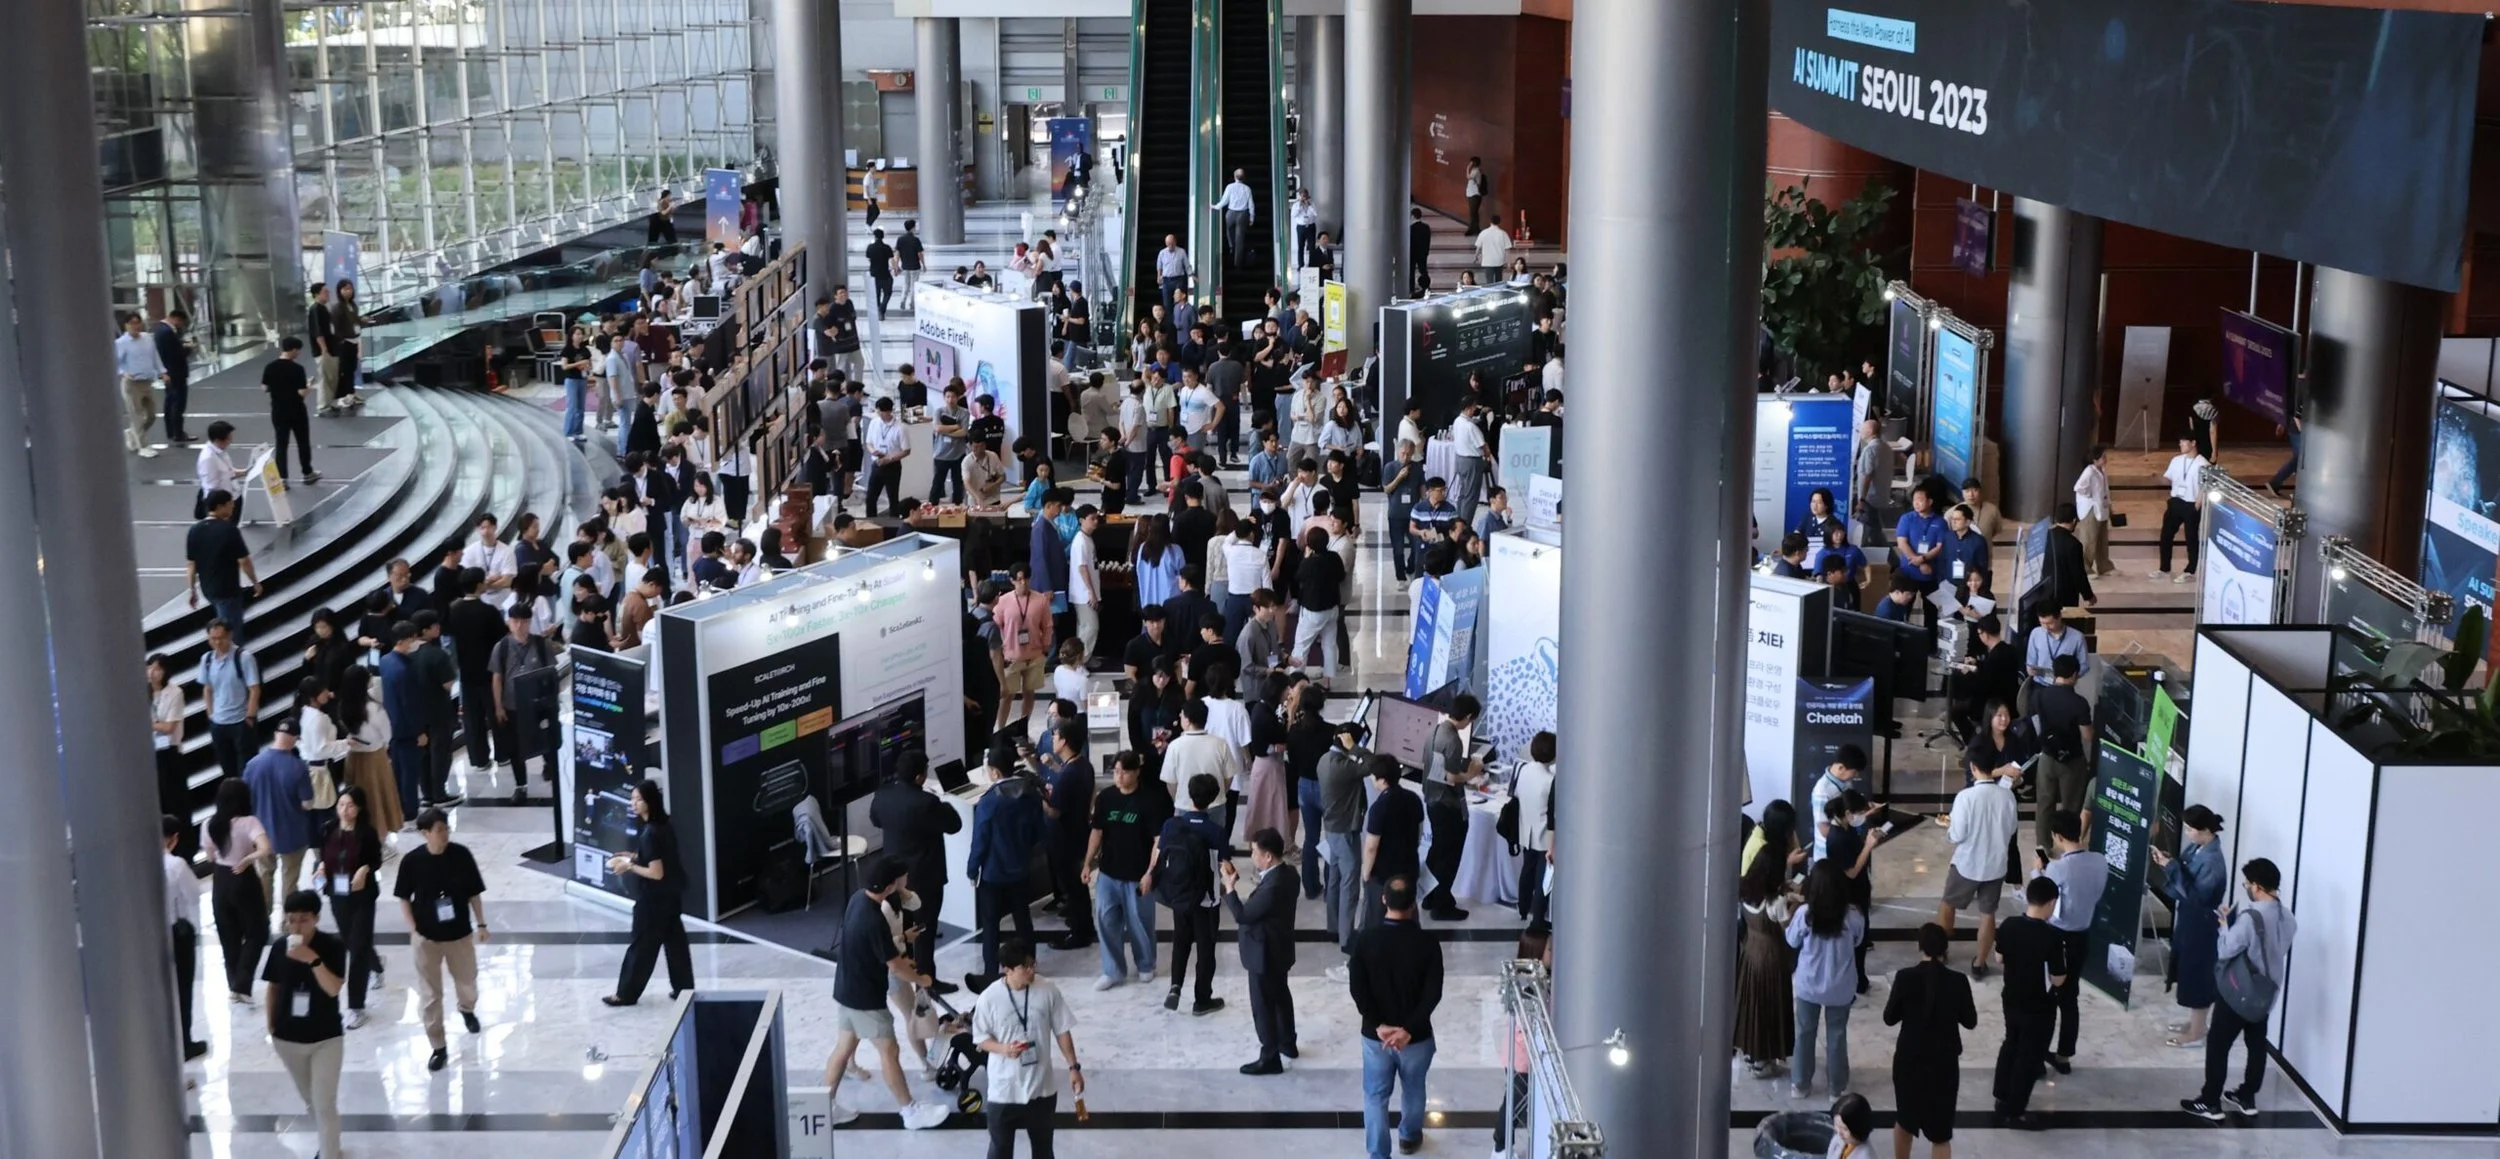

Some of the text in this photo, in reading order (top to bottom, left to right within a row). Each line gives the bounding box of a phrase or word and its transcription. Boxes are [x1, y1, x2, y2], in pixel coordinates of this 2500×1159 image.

[1861, 23, 1875, 39] New
[1875, 22, 1896, 44] Power
[1896, 27, 1905, 43] of
[1904, 28, 1913, 46] AI
[1793, 46, 1988, 136] AI SUMMIT SEOUL 2023
[919, 318, 975, 352] Adobe Firefly
[2468, 576, 2480, 592] AI
[1758, 631, 1784, 649] 치타
[725, 676, 826, 718] Speed-Up AI Training and Fine
[1764, 680, 1782, 694] 구성
[742, 711, 767, 725] Tuning
[766, 707, 777, 718] by
[1806, 711, 1864, 725] Cheetah
[800, 1114, 826, 1136] 1F
